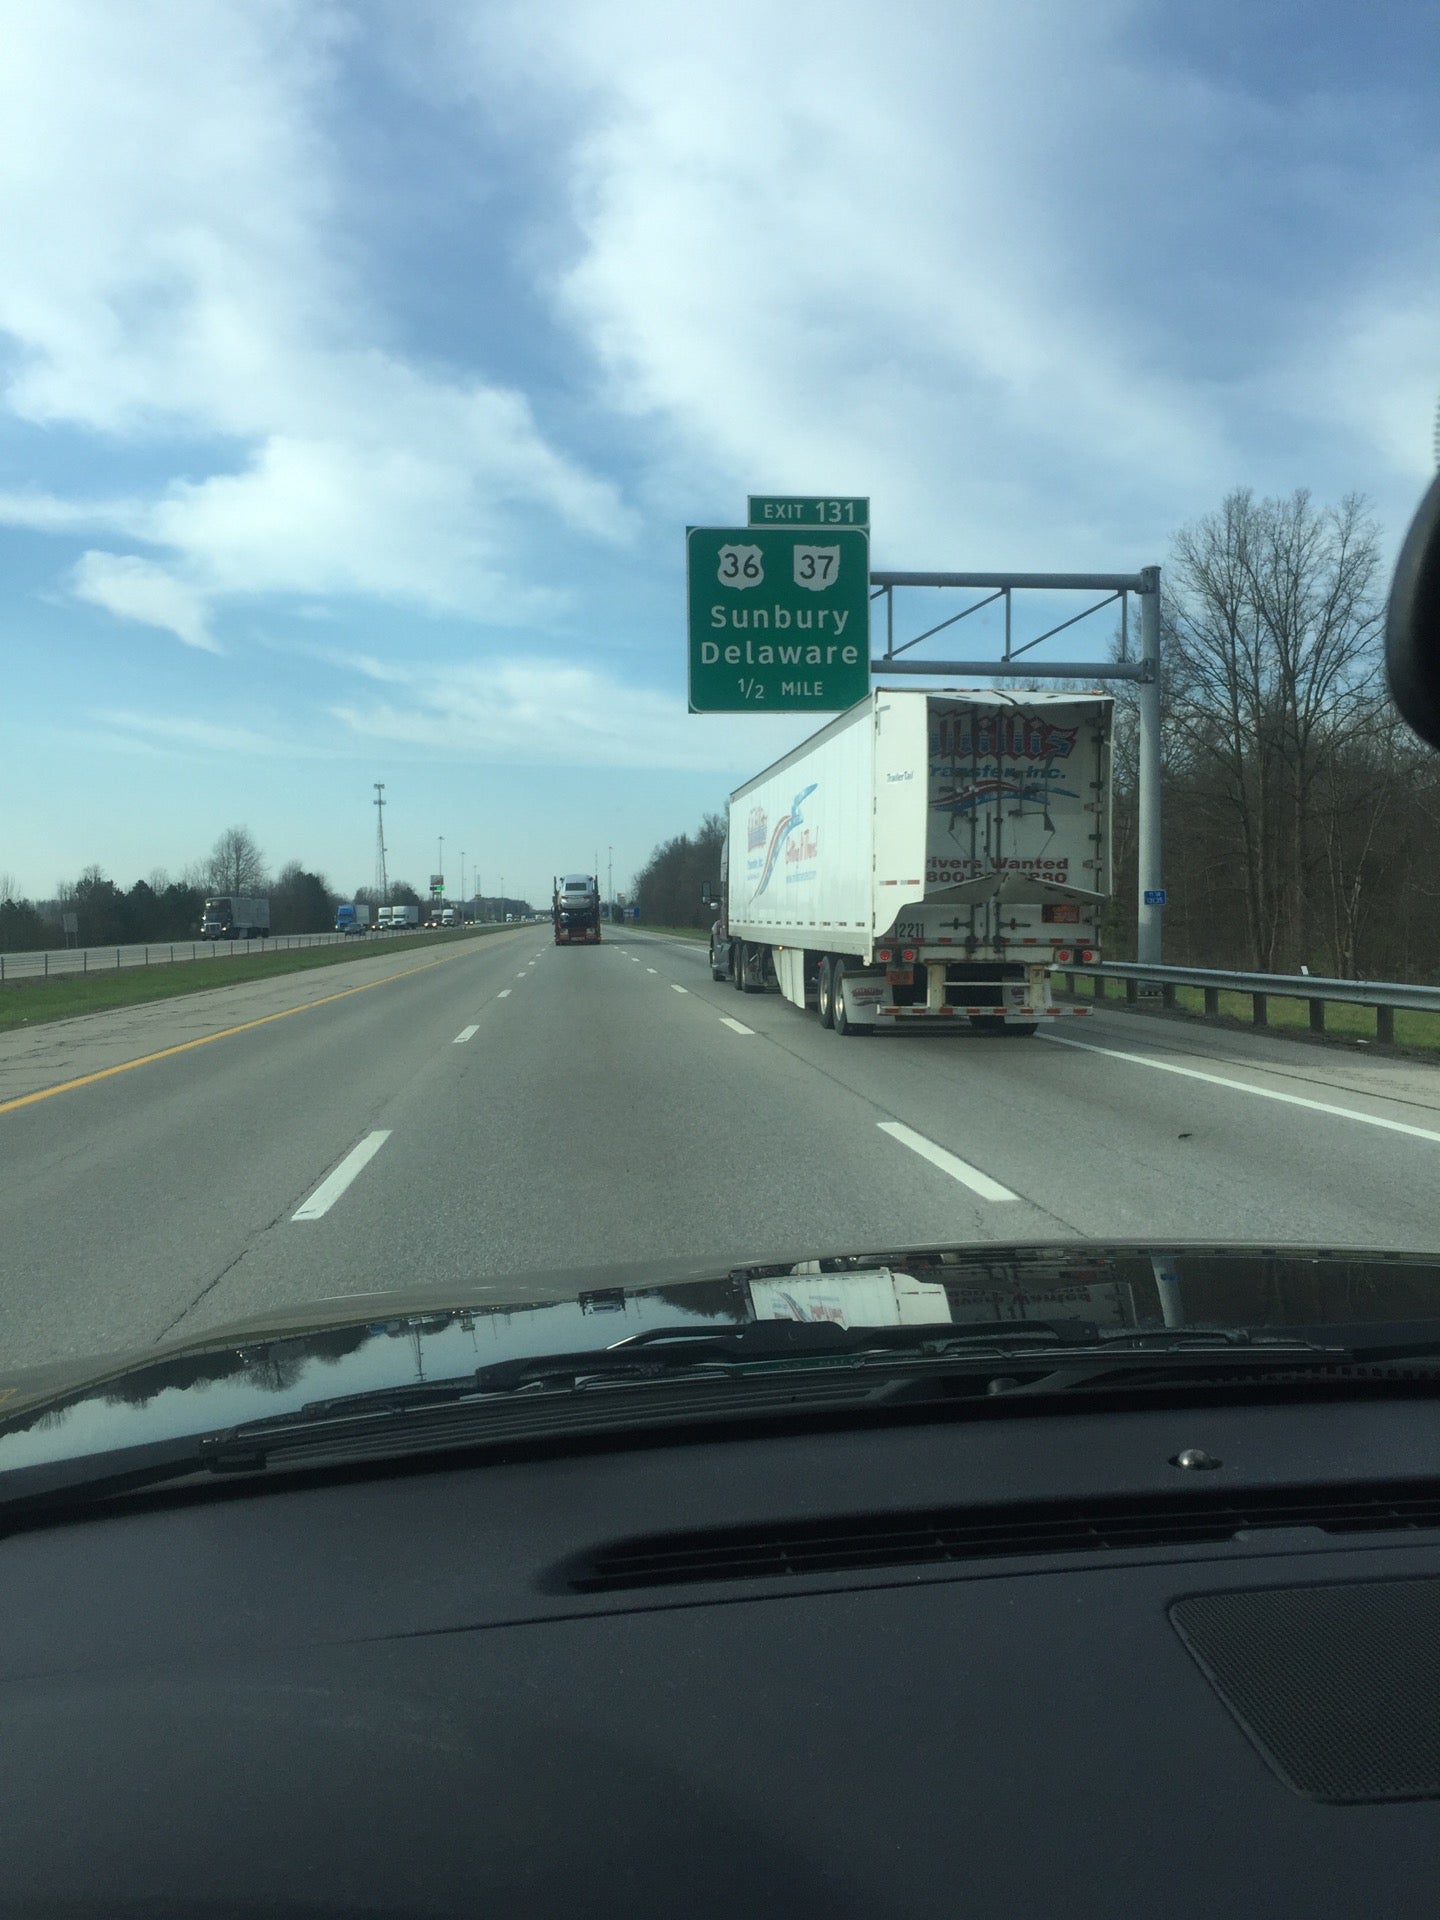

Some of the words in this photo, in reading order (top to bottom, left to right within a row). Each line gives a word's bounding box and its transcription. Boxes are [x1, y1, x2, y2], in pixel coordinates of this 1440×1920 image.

[764, 504, 804, 519] EXIT
[815, 502, 854, 522] 131
[723, 553, 760, 579] 36
[799, 555, 834, 580] 37
[711, 605, 849, 635] Sunbury
[701, 641, 859, 665] Delaware
[737, 679, 765, 700] 1/2
[781, 682, 824, 696] MILE
[990, 857, 1069, 869] Wanted
